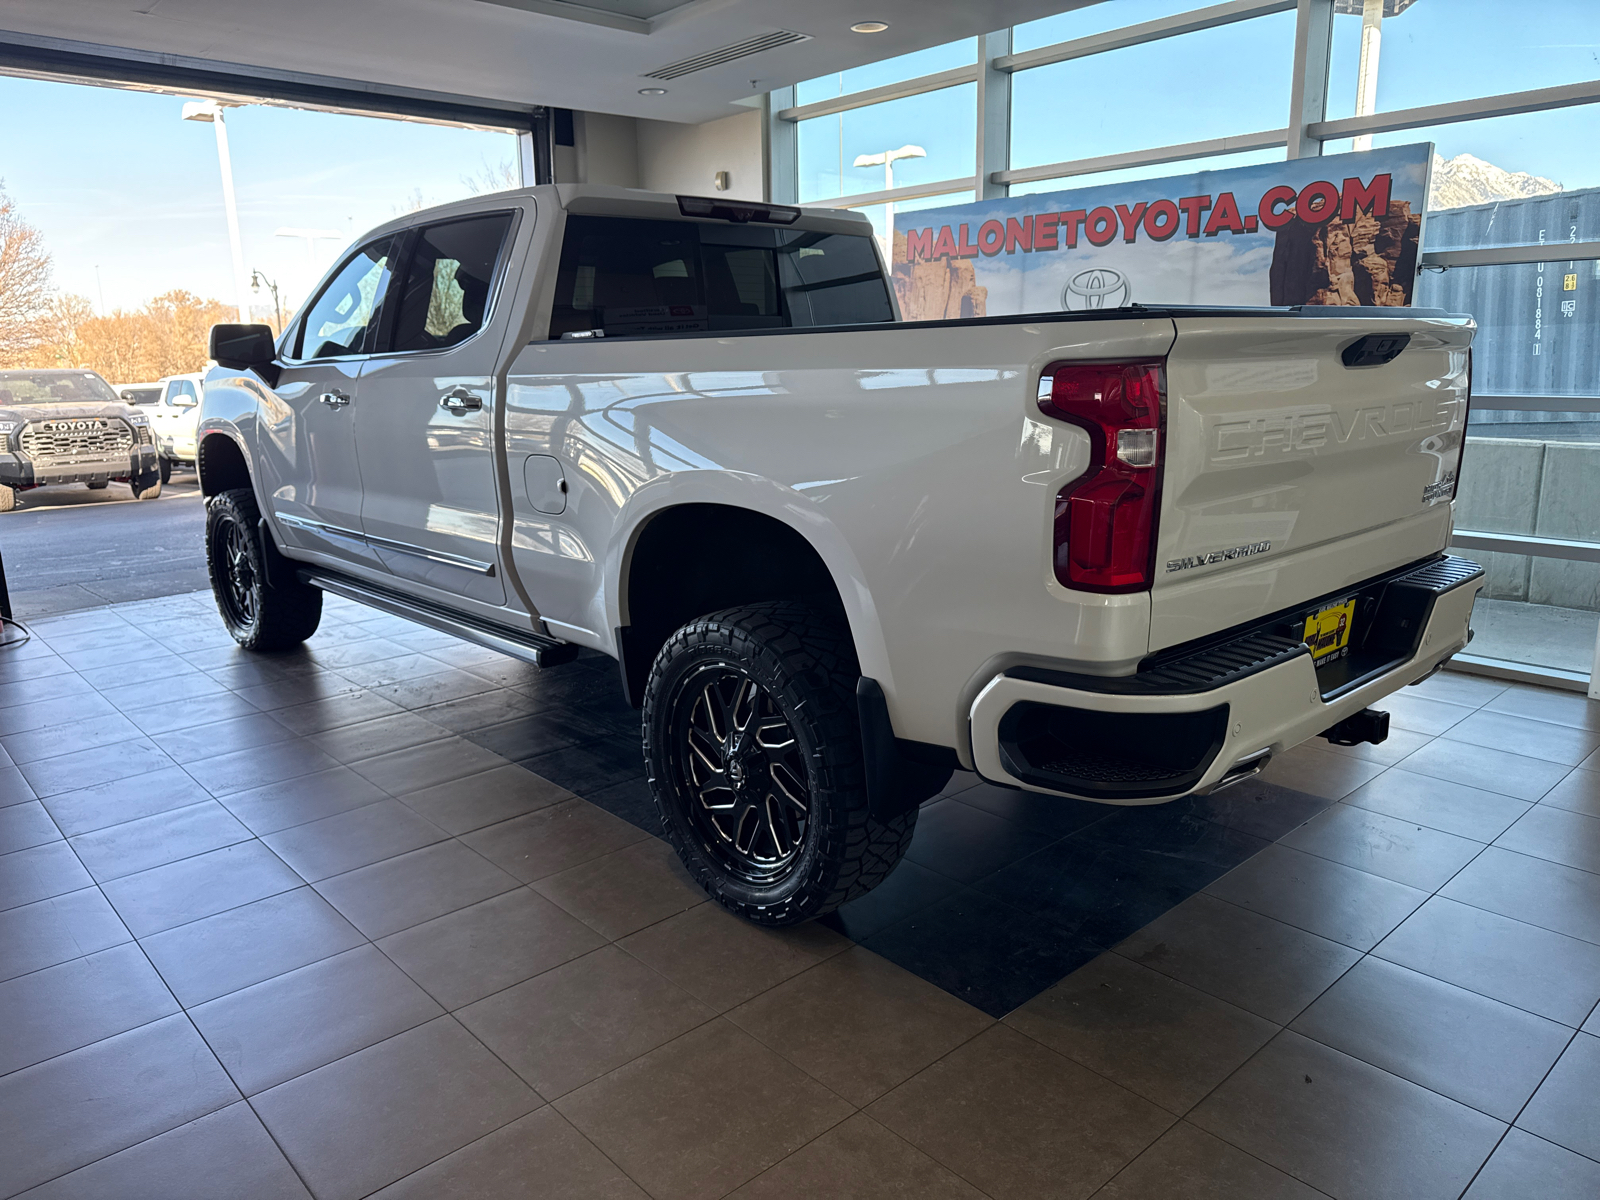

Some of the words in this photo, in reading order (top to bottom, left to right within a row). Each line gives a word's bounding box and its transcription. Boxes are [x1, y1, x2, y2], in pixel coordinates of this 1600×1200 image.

[906, 173, 1393, 263] MALONETOYOTA.COM
[50, 421, 102, 431] TOYOTA
[1210, 399, 1465, 463] CHEVROLET
[1166, 540, 1271, 573] SILVERADO
